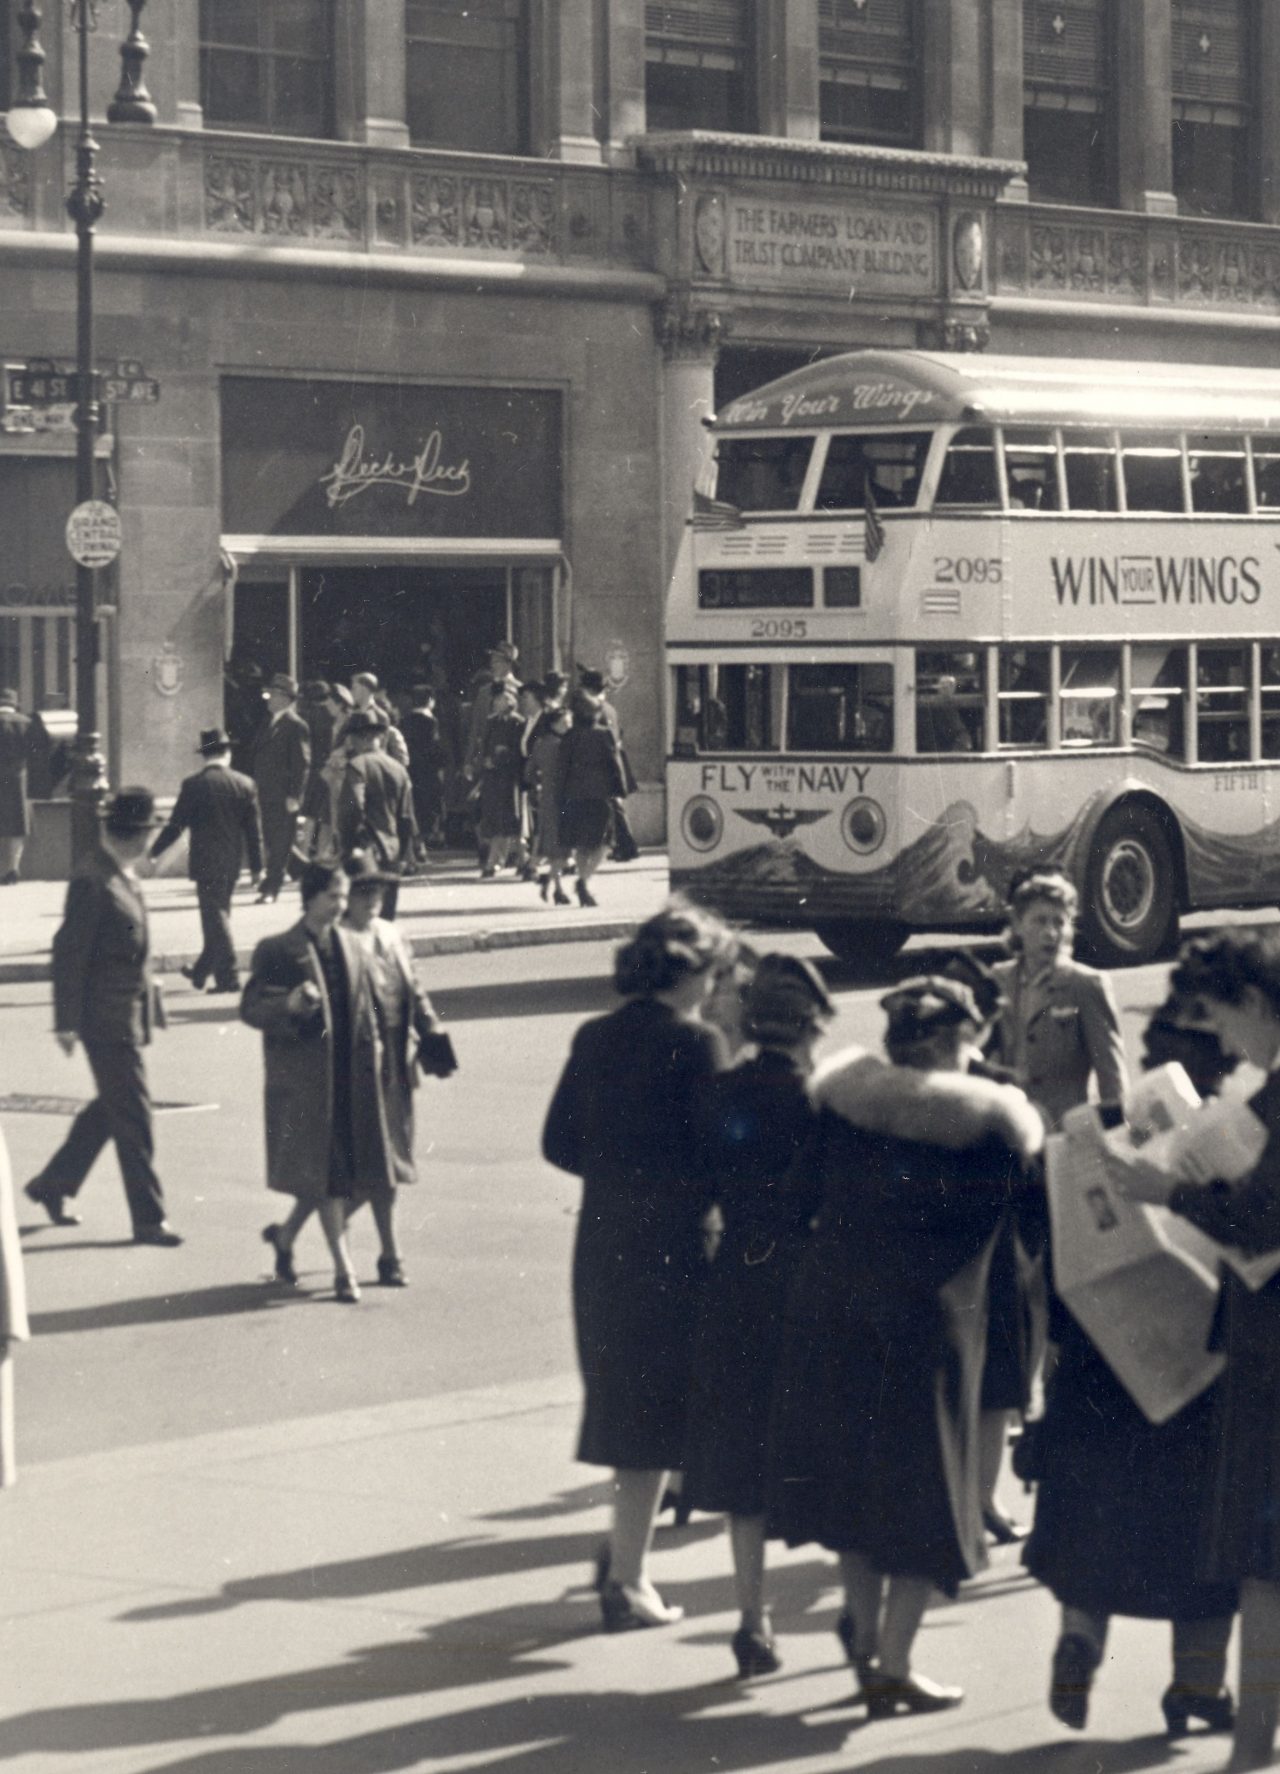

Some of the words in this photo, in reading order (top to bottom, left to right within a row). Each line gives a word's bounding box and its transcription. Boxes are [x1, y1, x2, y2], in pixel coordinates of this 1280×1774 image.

[735, 207, 765, 234] THE
[845, 214, 890, 243] LOAN
[895, 219, 928, 245] AND
[734, 239, 776, 266] TRUST
[781, 243, 858, 272] COMPANY
[863, 249, 929, 278] BUILDING
[725, 401, 769, 424] Win
[781, 393, 841, 425] Your
[853, 384, 938, 418] Wings
[933, 556, 1003, 584] 2095
[1050, 555, 1119, 606] WIN
[1121, 566, 1153, 593] YOUR
[1155, 555, 1262, 605] WINGS
[750, 619, 807, 639] 2095
[701, 765, 756, 792] FLY
[761, 765, 796, 777] WITH
[798, 765, 871, 793] NAVY
[1213, 771, 1259, 791] FIFTH
[767, 779, 791, 792] THE
